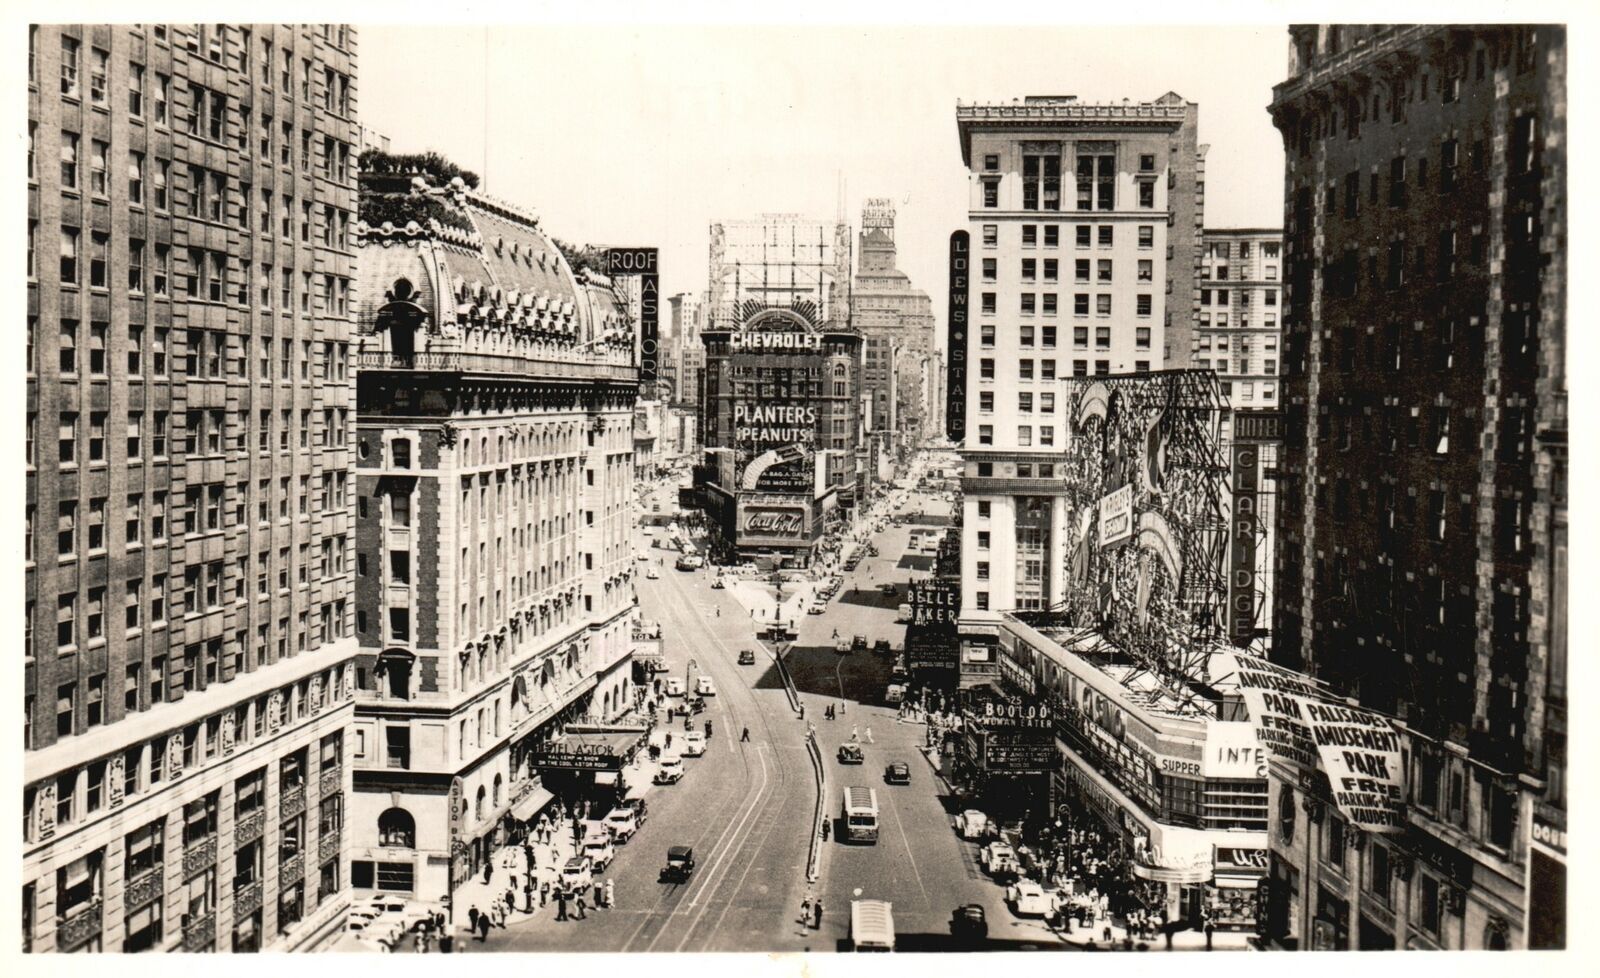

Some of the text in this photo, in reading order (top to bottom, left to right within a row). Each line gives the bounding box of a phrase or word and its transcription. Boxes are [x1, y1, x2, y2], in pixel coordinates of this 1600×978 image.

[611, 252, 657, 269] ROOF
[641, 278, 658, 375] ASTOR
[730, 333, 825, 348] CHEVROLET
[952, 349, 965, 431] STATE
[735, 405, 815, 424] PLANTERS
[743, 427, 807, 442] PEANUTS
[1235, 416, 1280, 437] HOTEL
[1233, 450, 1254, 637] CLARIDGE
[907, 590, 955, 606] BELLE
[907, 606, 955, 622] BAKER
[985, 702, 1047, 719] BOOLOO
[1306, 703, 1388, 728] PALISADES
[1261, 714, 1313, 740] FREE
[1313, 725, 1399, 753] AMUSEMENT
[1162, 759, 1201, 776] SUPPER
[1341, 751, 1391, 780] PARK
[1340, 777, 1401, 799] FREE
[451, 779, 459, 821] ASTOR
